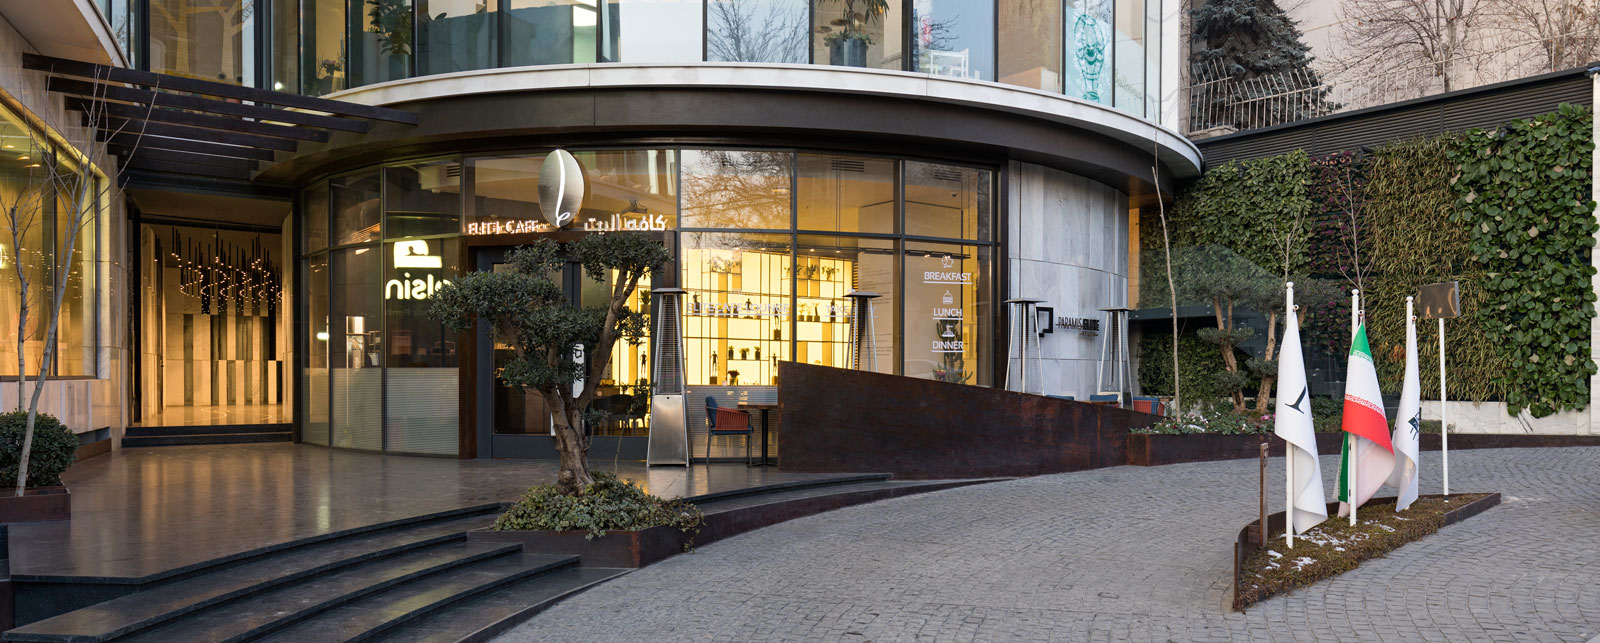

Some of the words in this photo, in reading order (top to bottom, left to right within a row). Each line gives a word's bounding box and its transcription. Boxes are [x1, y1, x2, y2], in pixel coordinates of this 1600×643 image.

[924, 271, 972, 281] BREAKFAST
[746, 302, 790, 314] LOUNGE
[933, 307, 963, 317] LUNCH
[932, 340, 964, 350] DINNER
